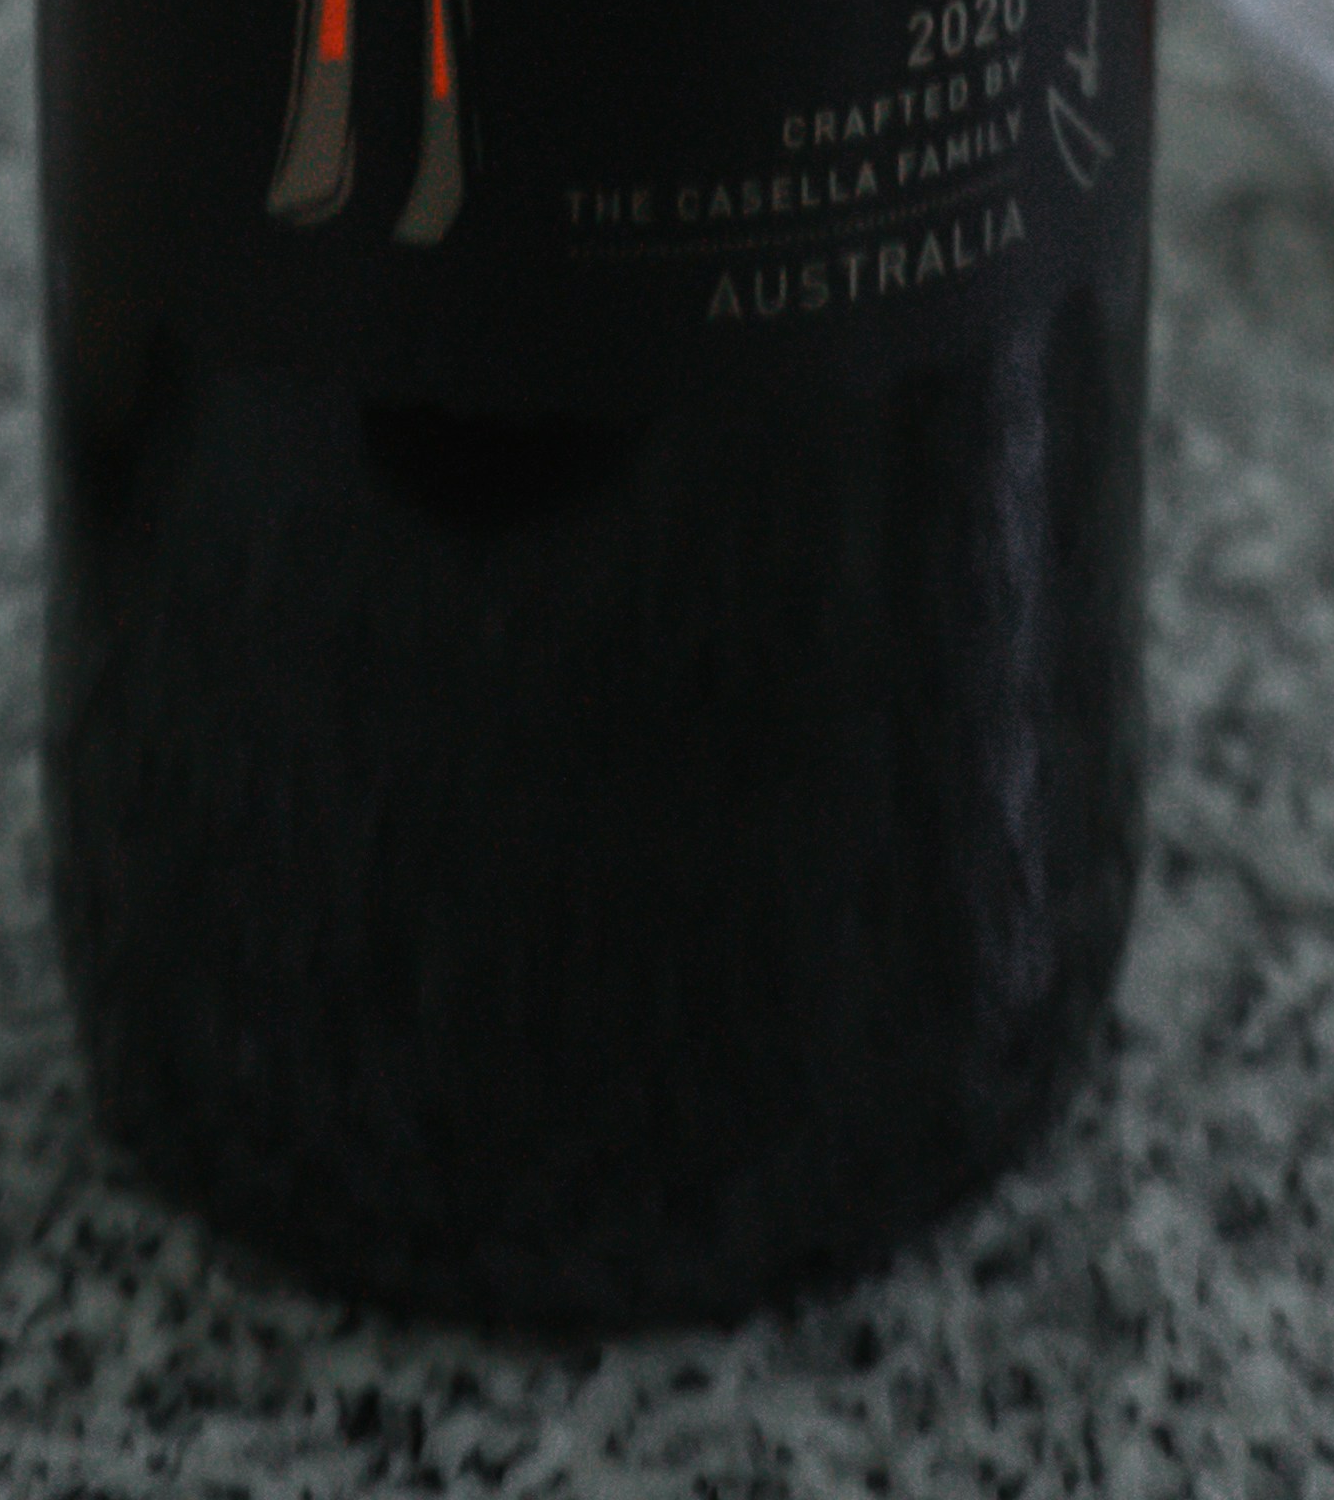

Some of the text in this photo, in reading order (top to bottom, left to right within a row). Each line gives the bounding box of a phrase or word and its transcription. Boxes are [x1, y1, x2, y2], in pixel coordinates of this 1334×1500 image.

[781, 51, 1025, 150] CRAFTED BY
[564, 105, 1025, 224] THE CASELLA FAMILY
[706, 197, 1027, 321] AUSTRALIA
